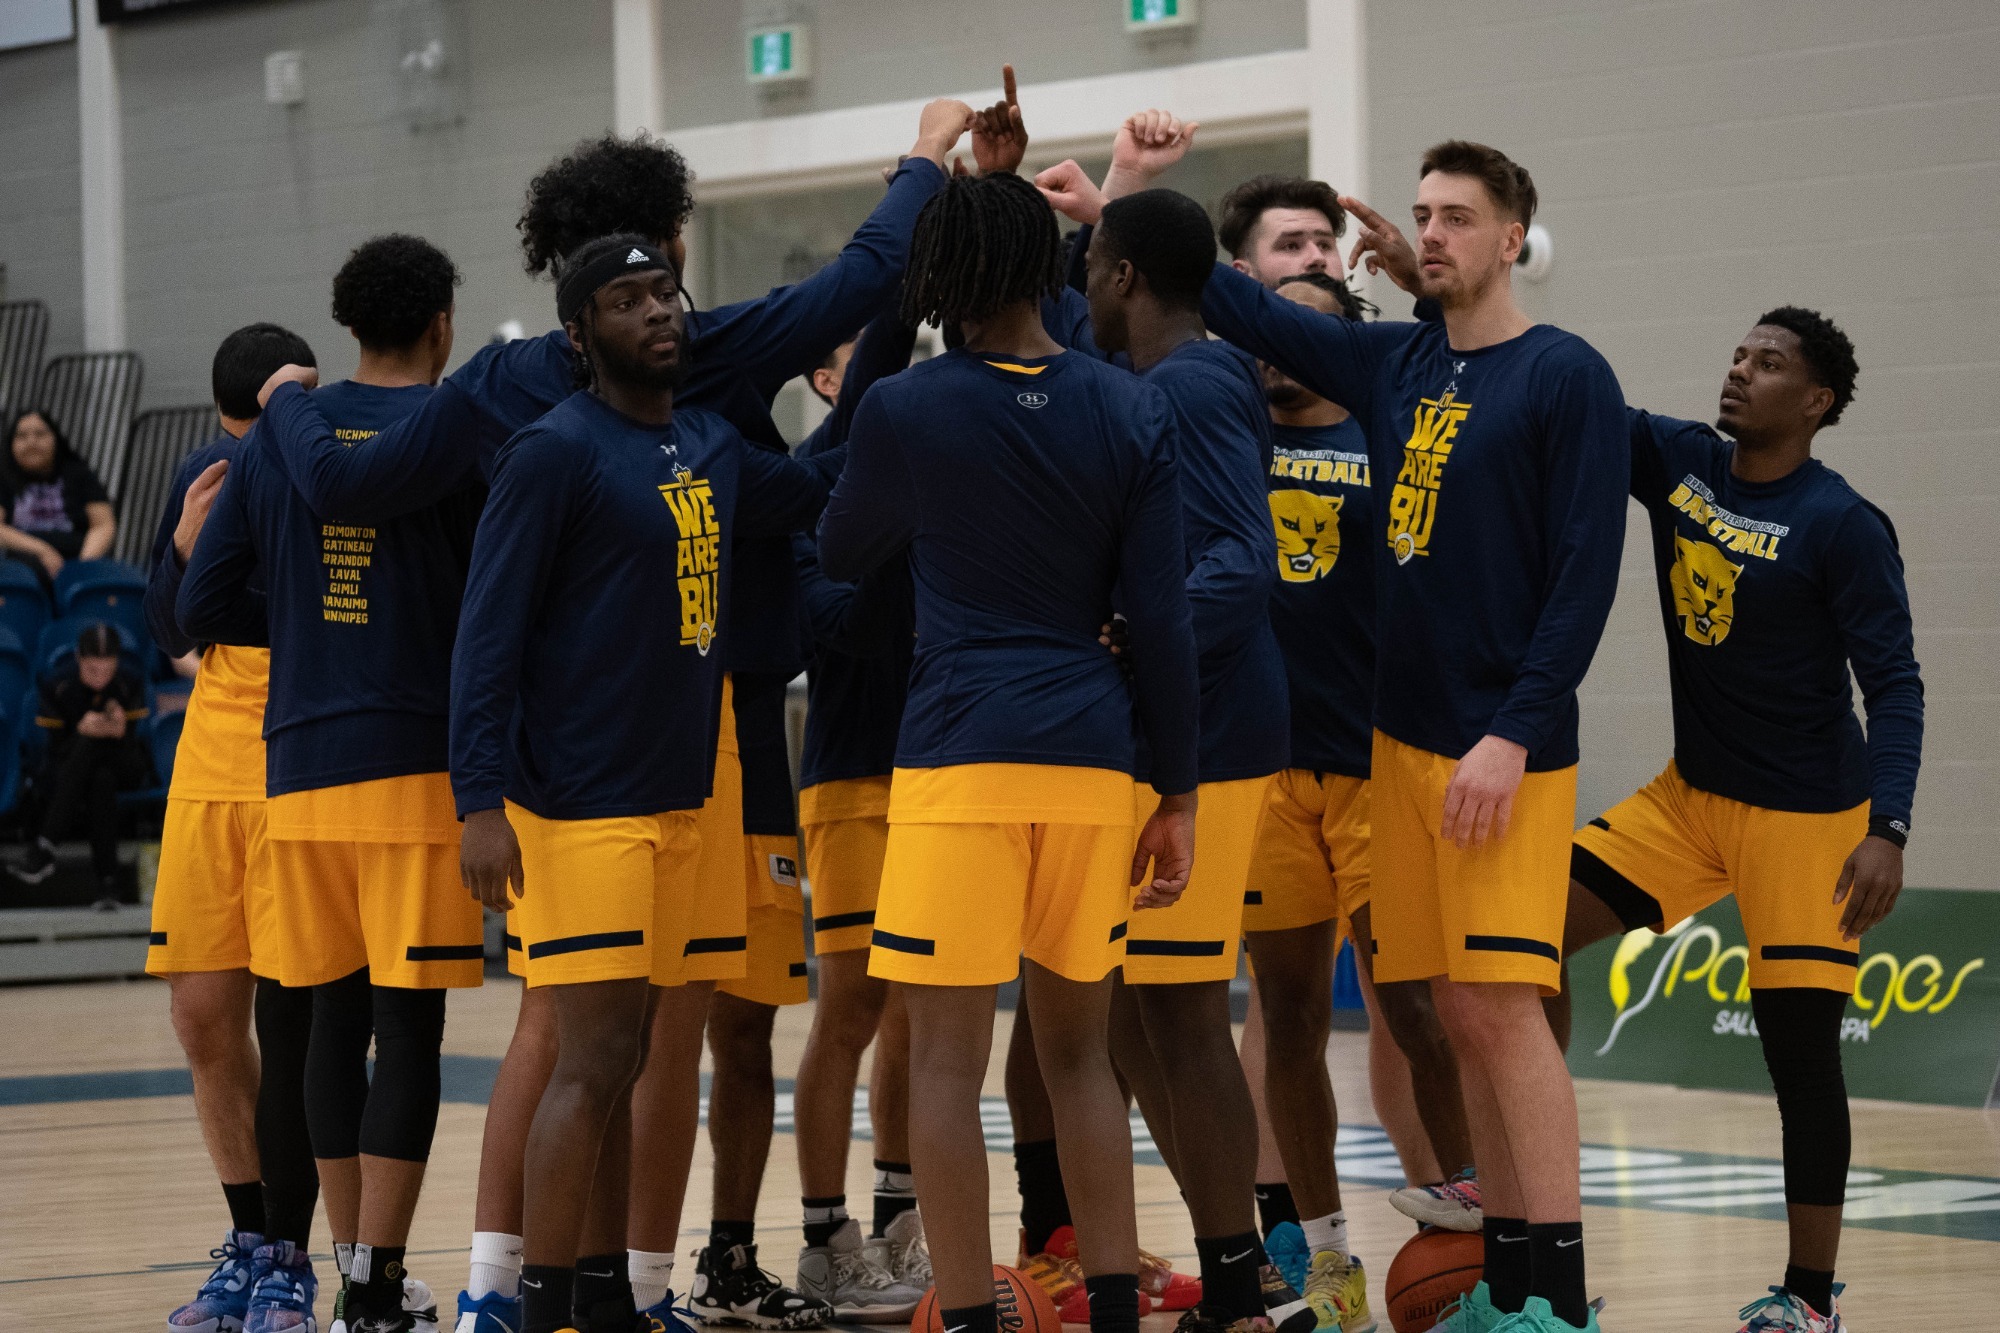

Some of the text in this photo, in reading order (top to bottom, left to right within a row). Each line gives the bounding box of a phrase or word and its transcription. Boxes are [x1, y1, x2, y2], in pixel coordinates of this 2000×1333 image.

[335, 428, 379, 440] RICHMO
[1405, 405, 1469, 455] WE
[1281, 448, 1334, 460] IVERSITY
[1334, 451, 1369, 464] BOBCA
[1397, 449, 1448, 490] ARE
[1270, 454, 1371, 488] KETBAL
[1683, 473, 1715, 502] BRAN
[661, 485, 719, 539] WE
[1387, 483, 1438, 548] BU
[322, 525, 376, 539] EDMONTON
[323, 539, 373, 553] GATINEAU
[322, 552, 371, 567] BRANDON
[676, 534, 720, 577] ARE
[330, 568, 361, 581] LAVAL
[330, 582, 359, 595] GIMLI
[323, 609, 369, 624] WNNIPEG
[677, 572, 718, 640] BU
[1663, 923, 1985, 1029] Pages
[1712, 1010, 1761, 1037] SAL
